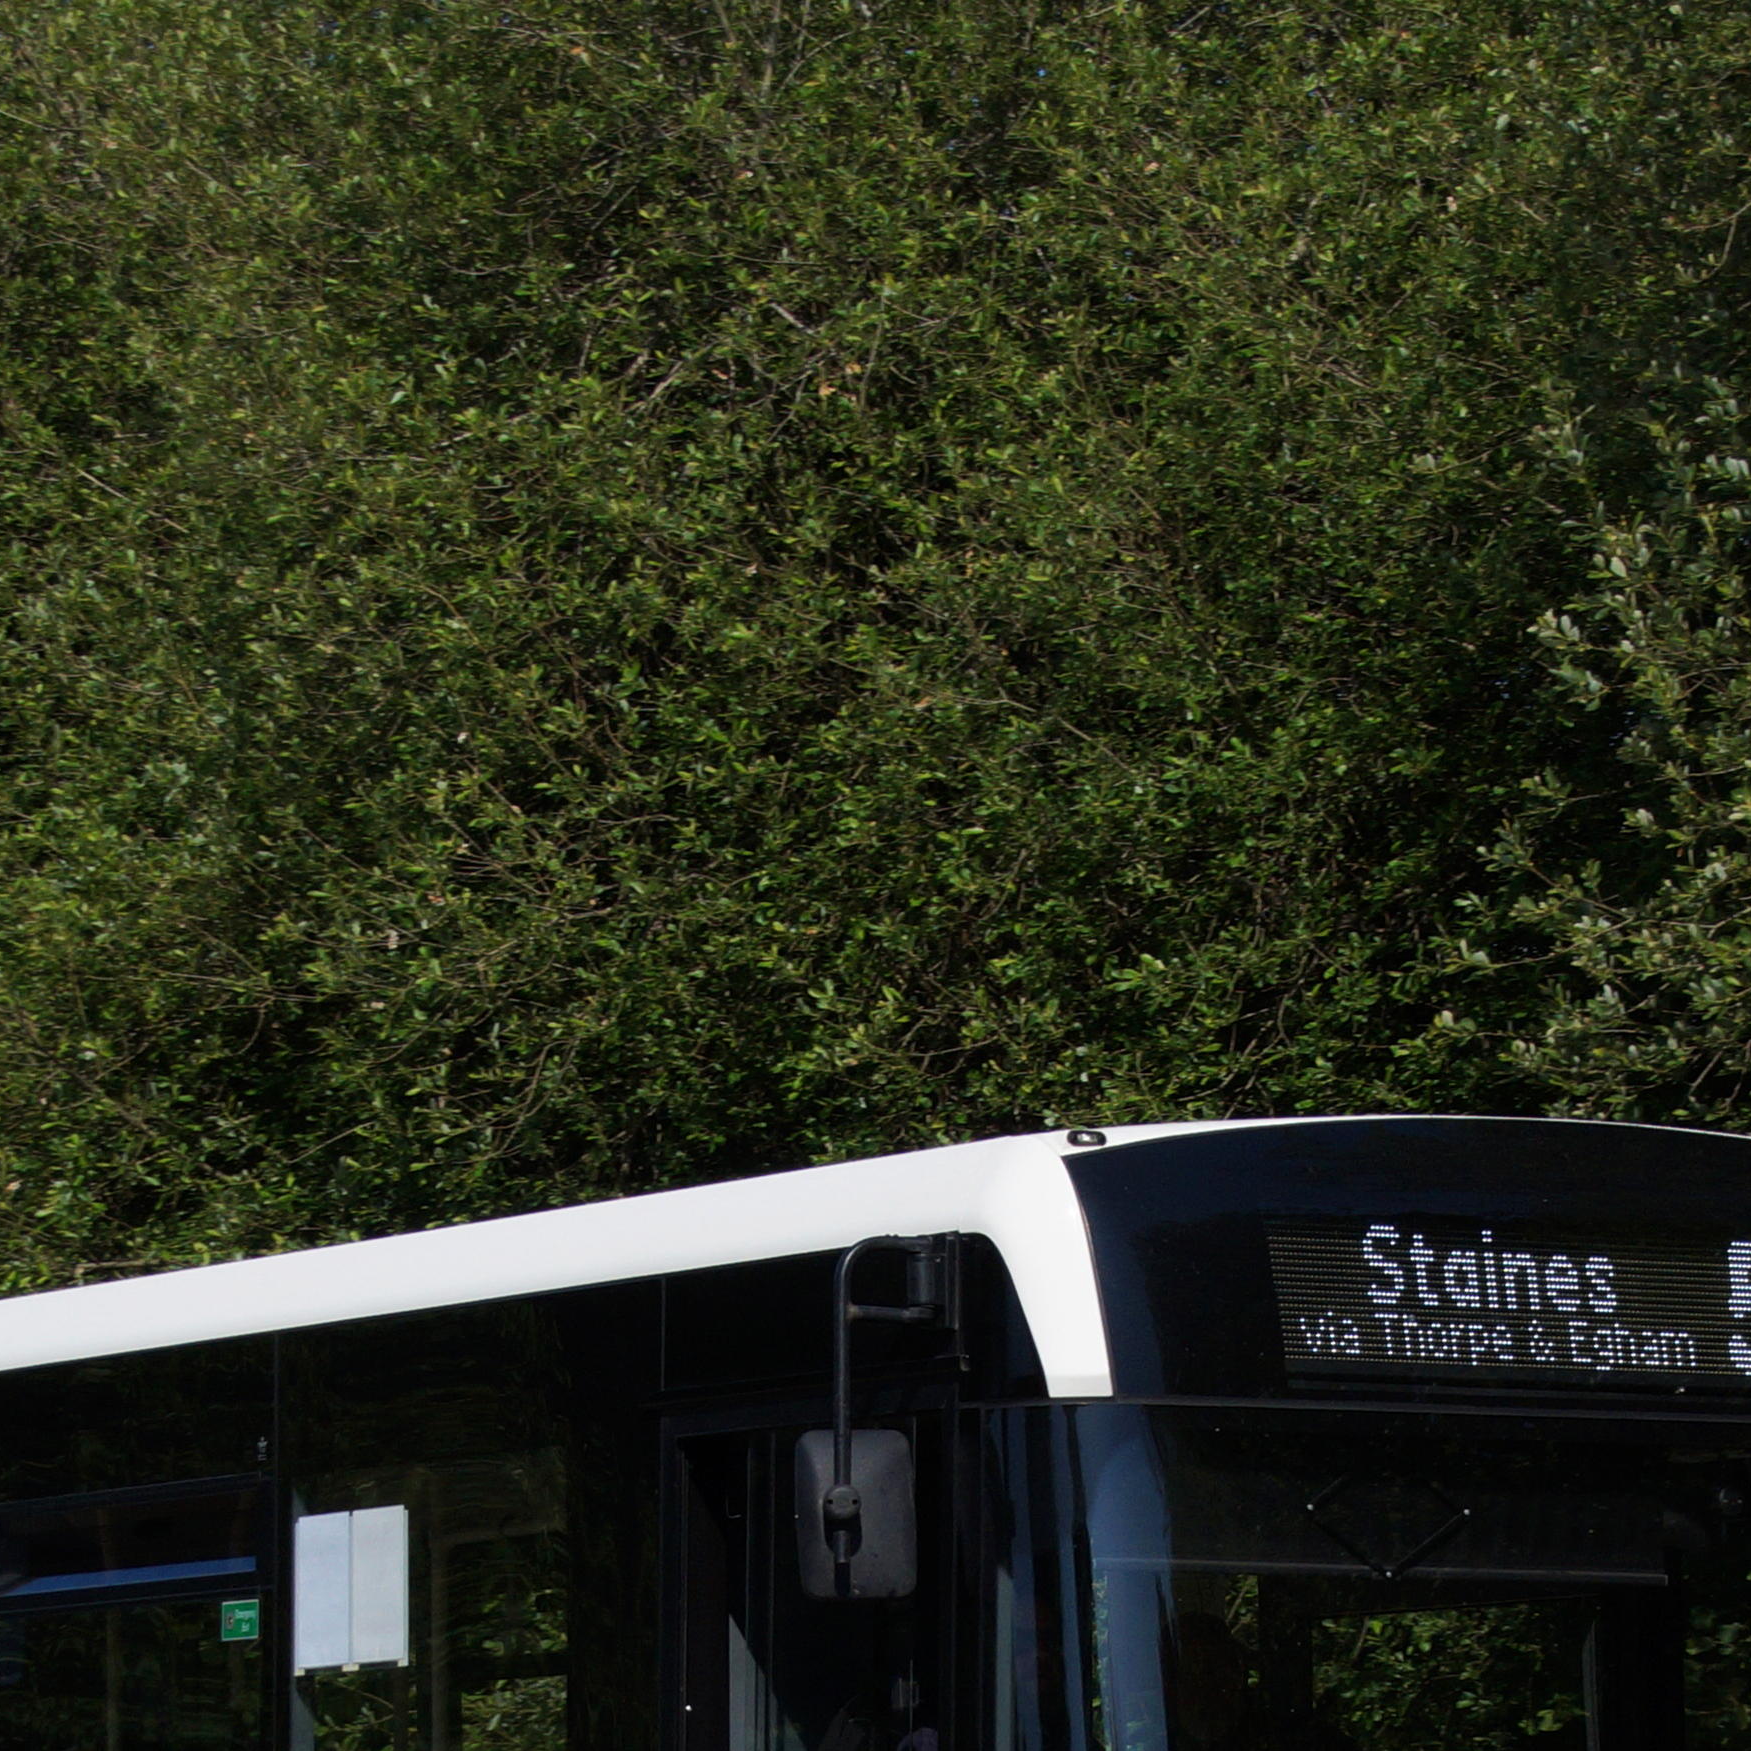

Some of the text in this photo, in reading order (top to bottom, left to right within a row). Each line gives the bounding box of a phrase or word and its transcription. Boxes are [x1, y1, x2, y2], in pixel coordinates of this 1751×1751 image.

[1361, 1224, 1618, 1313] Staines
[1299, 1311, 1361, 1355] via
[1373, 1312, 1514, 1366] Thorpe
[1567, 1320, 1698, 1372] Egham
